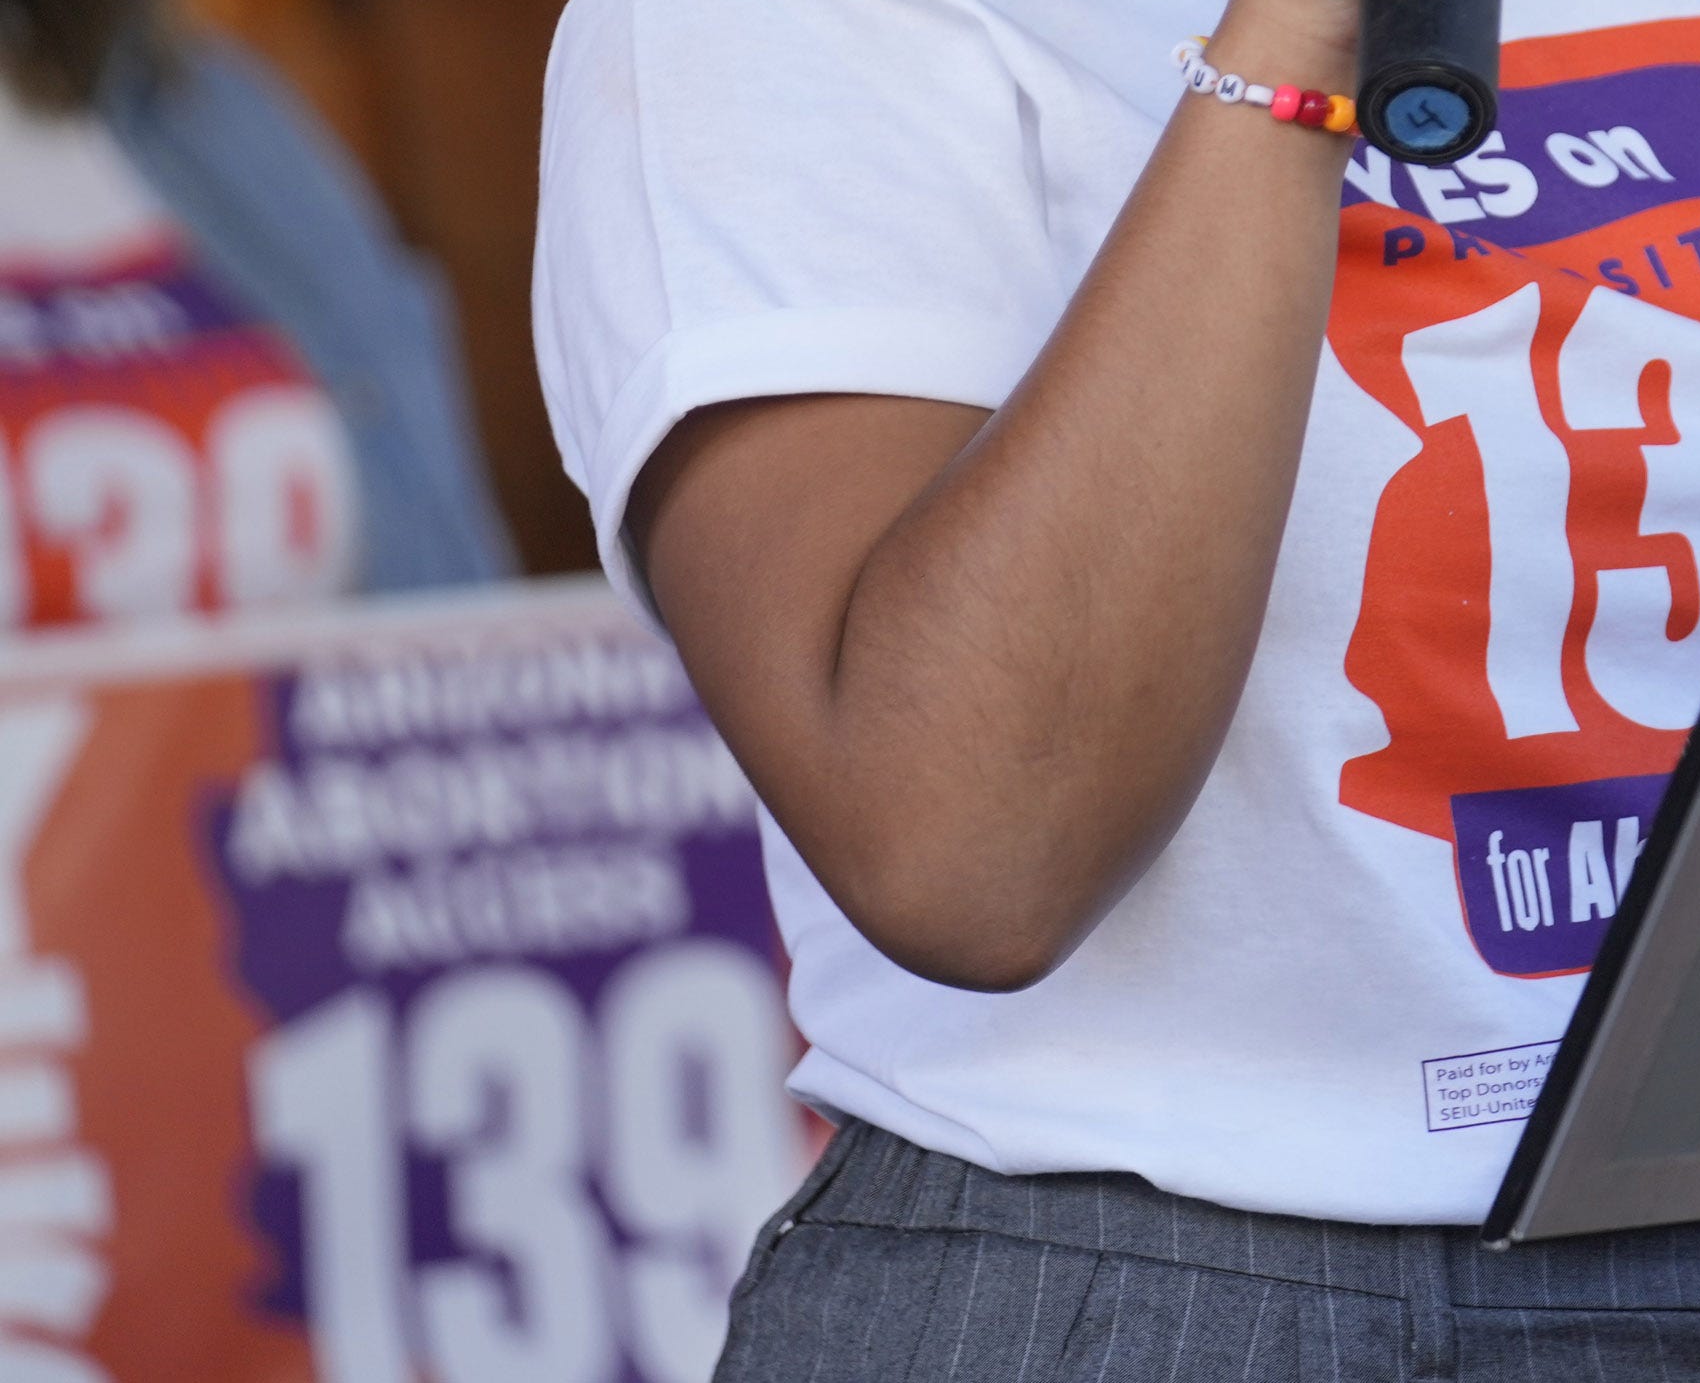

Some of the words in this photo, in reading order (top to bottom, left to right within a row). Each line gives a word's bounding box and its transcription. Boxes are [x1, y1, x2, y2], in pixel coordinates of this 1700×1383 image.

[1344, 130, 1538, 225] YES
[1545, 126, 1674, 188] on
[1486, 829, 1554, 932] for
[1436, 1066, 1474, 1082] Paid
[1479, 1063, 1503, 1076] for
[1508, 1057, 1530, 1073] by
[1438, 1087, 1472, 1102] Top
[257, 947, 798, 1382] 139
